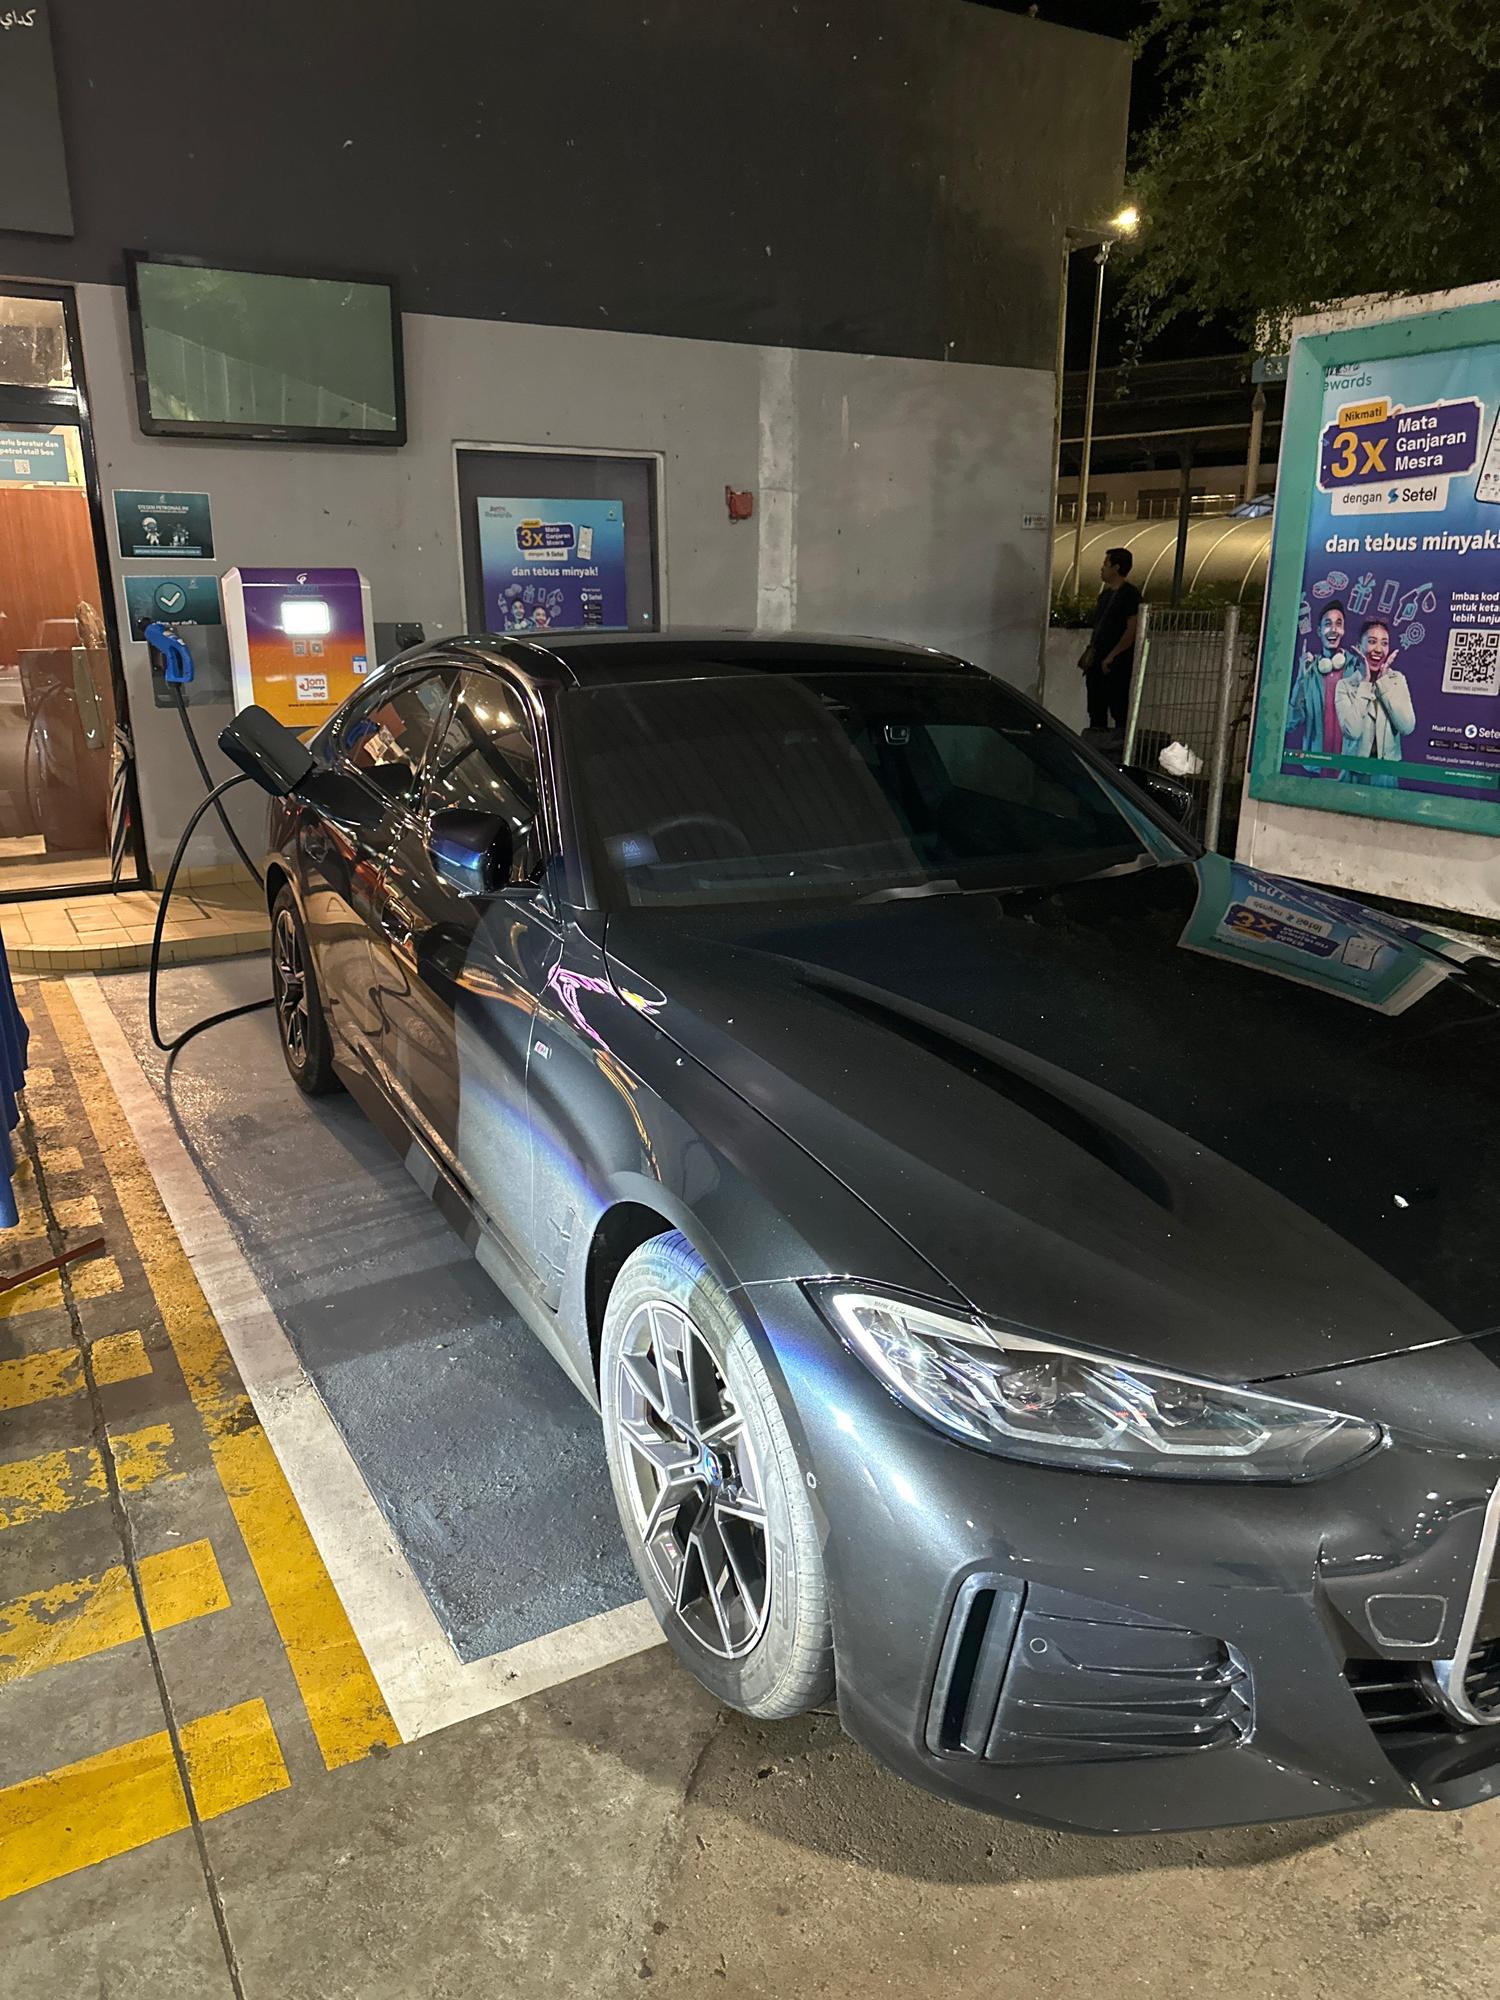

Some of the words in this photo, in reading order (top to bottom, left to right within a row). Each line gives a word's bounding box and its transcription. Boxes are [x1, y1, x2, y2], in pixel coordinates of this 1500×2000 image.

[1345, 407, 1382, 422] Nikmati
[1397, 416, 1438, 434] Mata
[1396, 431, 1467, 452] Ganjaran
[1331, 431, 1389, 478] 3x
[1395, 454, 1443, 471] Mesra
[1342, 493, 1382, 505] dengan
[1402, 486, 1438, 502] Setel
[521, 529, 544, 547] 3x
[1325, 534, 1360, 553] dan
[1364, 533, 1418, 552] tebus
[512, 567, 531, 577] dan
[533, 567, 560, 576] tebus
[562, 566, 599, 578] minyak!
[1452, 592, 1479, 601] Imbas
[1481, 592, 1500, 601] kod
[1450, 603, 1477, 612] untuk
[1452, 613, 1476, 623] lebih
